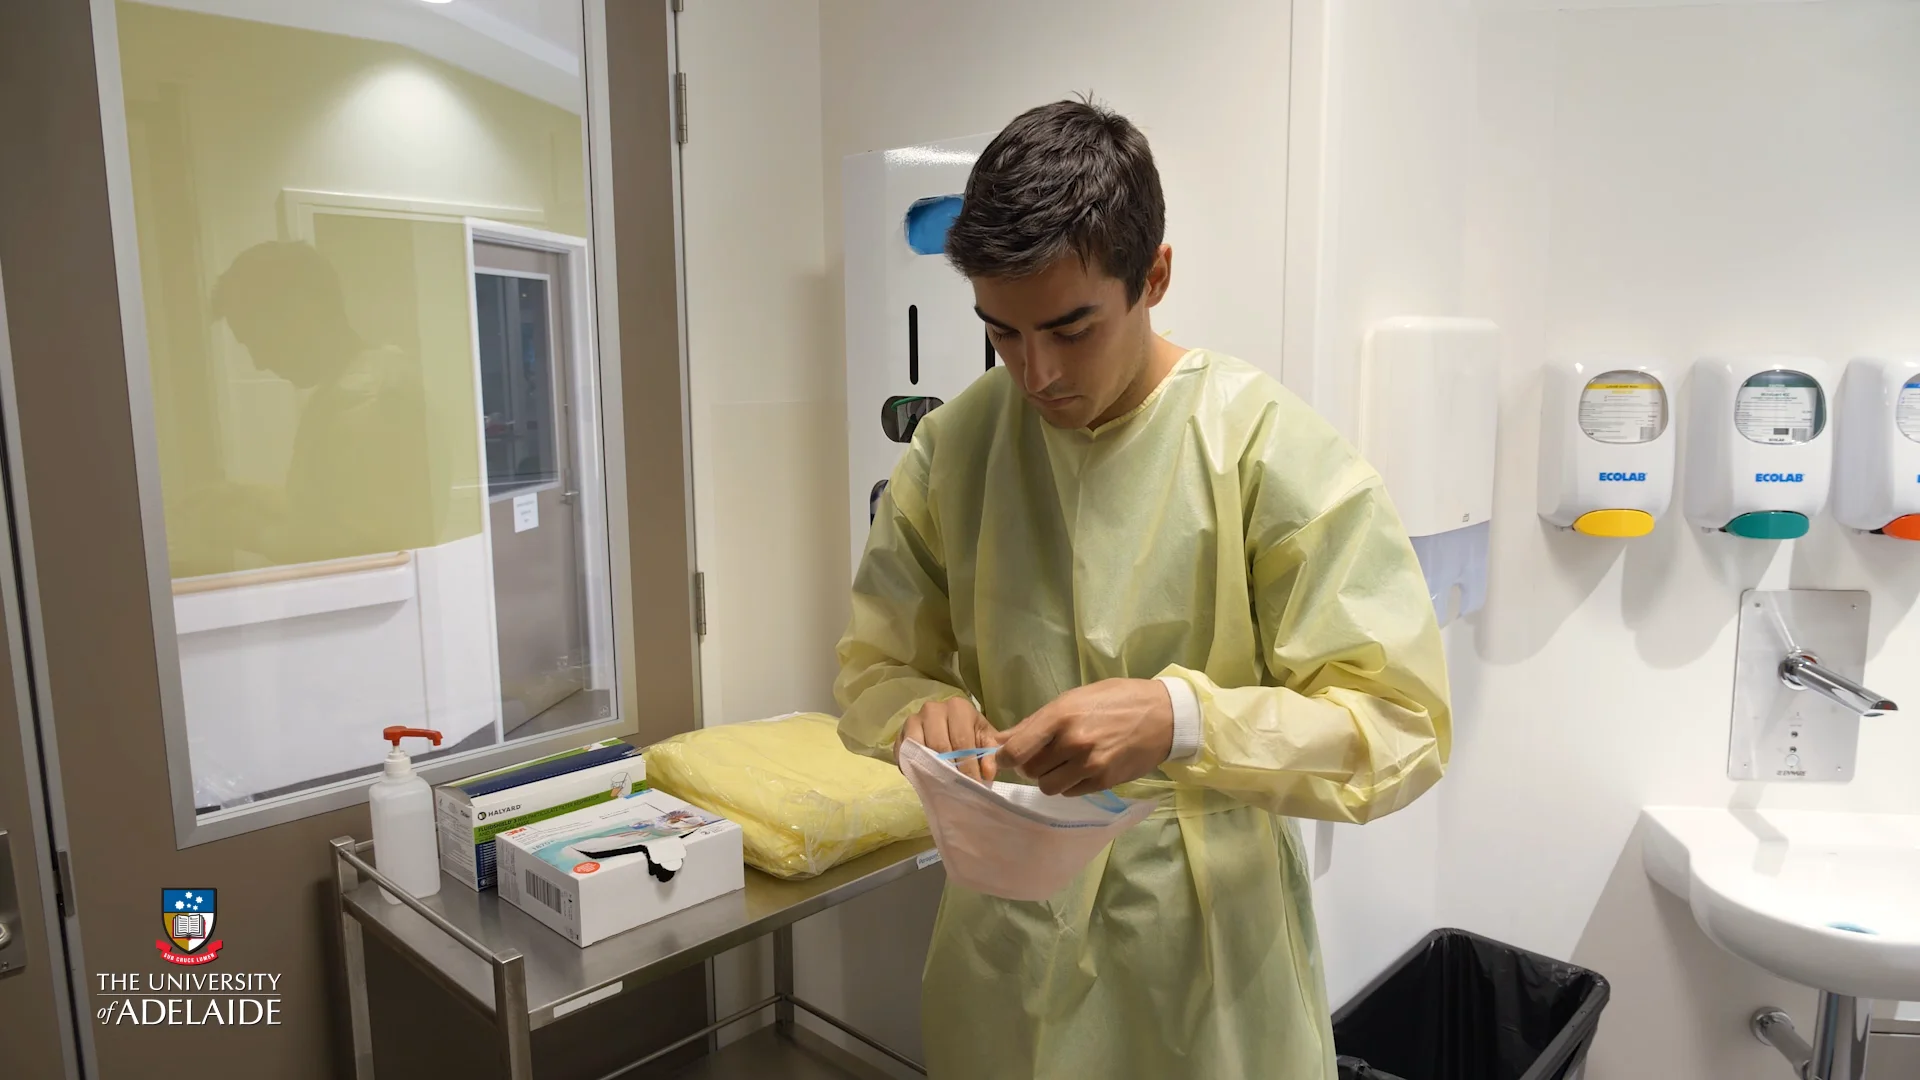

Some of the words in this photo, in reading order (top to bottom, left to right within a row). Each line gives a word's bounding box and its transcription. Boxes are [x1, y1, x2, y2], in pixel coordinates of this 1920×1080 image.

[1599, 472, 1646, 482] ECOLAB
[1755, 473, 1803, 483] ECOLAB
[488, 804, 521, 817] HALYARD
[505, 827, 527, 837] 3M
